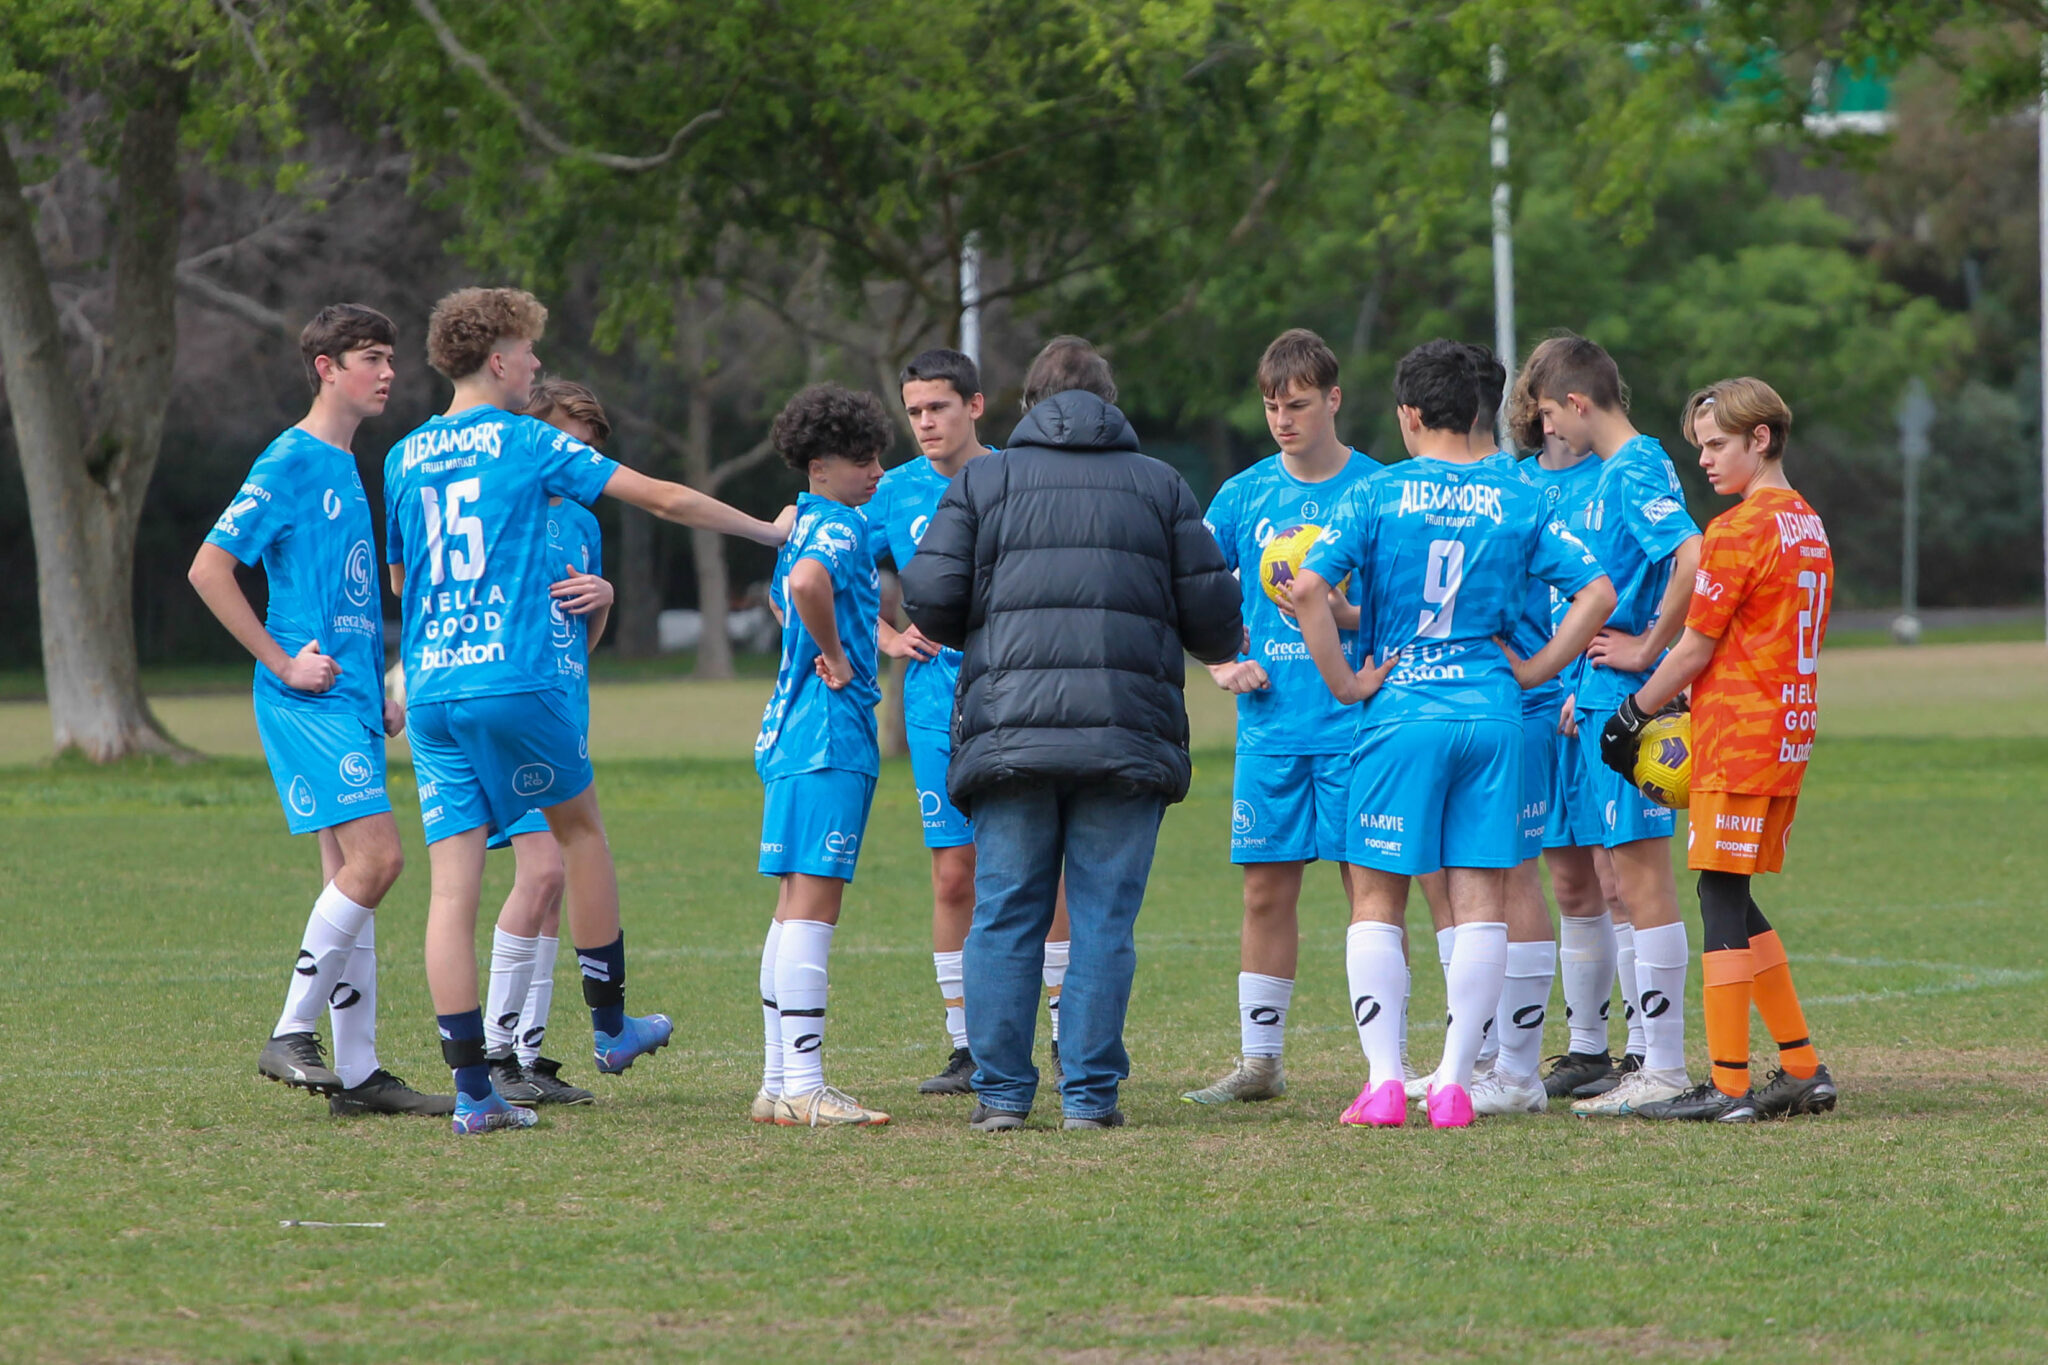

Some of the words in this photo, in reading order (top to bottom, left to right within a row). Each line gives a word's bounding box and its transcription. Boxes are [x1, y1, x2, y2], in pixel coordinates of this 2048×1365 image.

[402, 422, 504, 478] ALEXANDERS
[421, 461, 444, 474] FRUIT
[445, 453, 477, 470] MARKET
[1397, 480, 1503, 525] ALEXANDERS
[420, 477, 486, 586] 15
[1425, 513, 1445, 526] FRUIT
[421, 584, 506, 615] HELLA
[1418, 539, 1465, 639] 9
[424, 611, 501, 640] GOOD
[1797, 570, 1827, 676] 21
[421, 640, 506, 671] buxton
[1264, 639, 1306, 656] Greca
[1360, 813, 1404, 832] HARVIE
[1715, 813, 1765, 833] HARVIE
[1365, 838, 1402, 852] FOODNET
[1715, 840, 1760, 853] FOODNET
